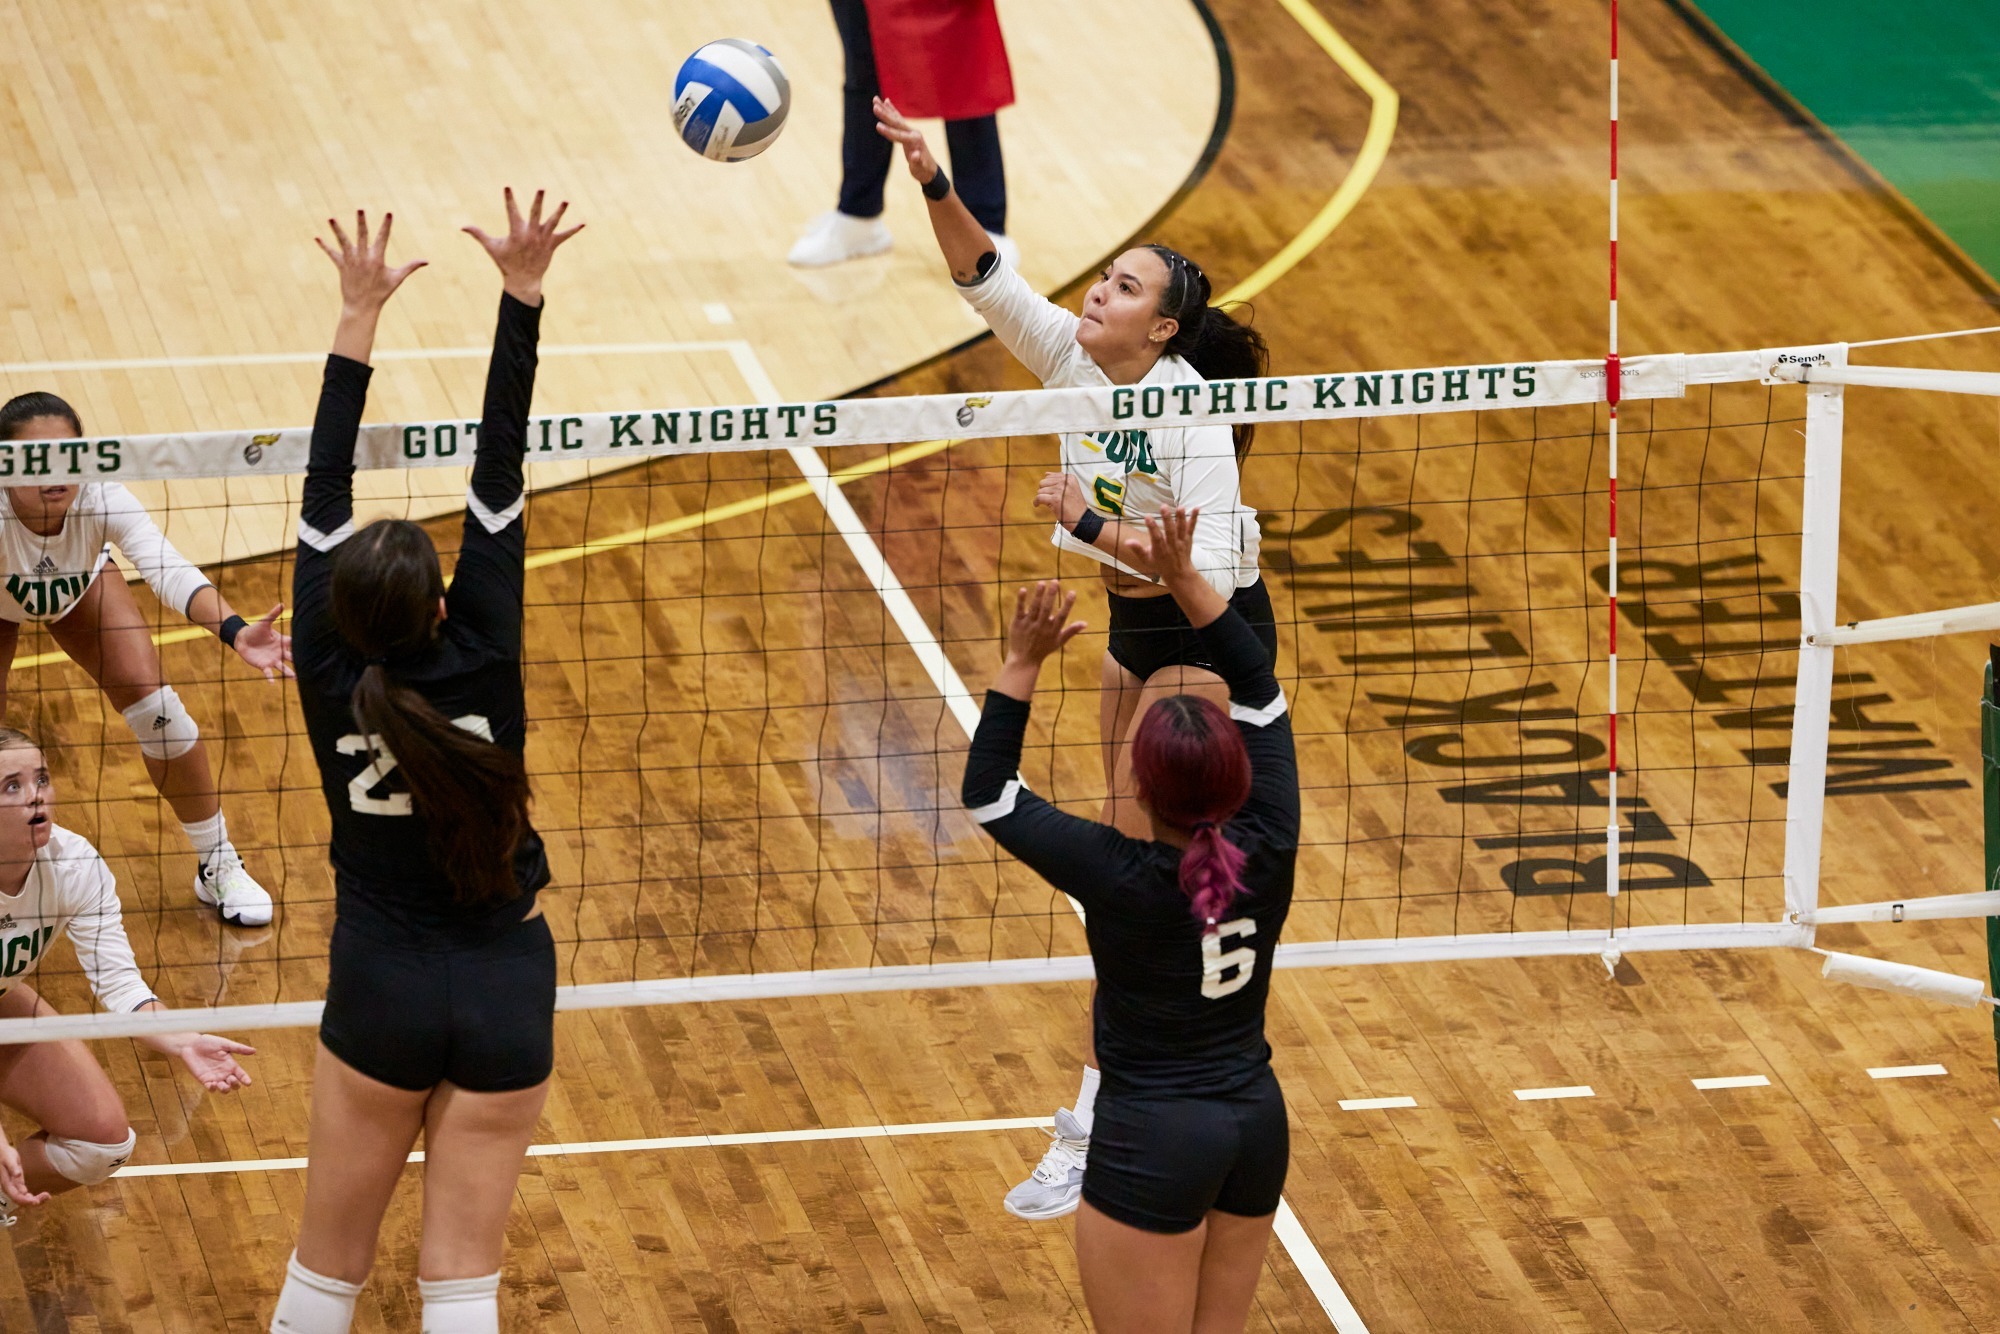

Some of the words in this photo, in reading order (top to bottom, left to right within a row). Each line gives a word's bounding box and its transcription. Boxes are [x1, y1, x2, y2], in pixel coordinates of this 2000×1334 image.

[1112, 379, 1289, 420] GOTHIC
[1313, 365, 1537, 409] KNIGHTS
[1789, 353, 1826, 364] Senoh
[403, 417, 583, 459] GOIC
[609, 403, 837, 448] KNIGHTS
[1256, 507, 1530, 665] LIVES
[1591, 553, 1973, 800] MATTER
[1366, 682, 1714, 897] BLACK
[1201, 917, 1257, 1000] 6
